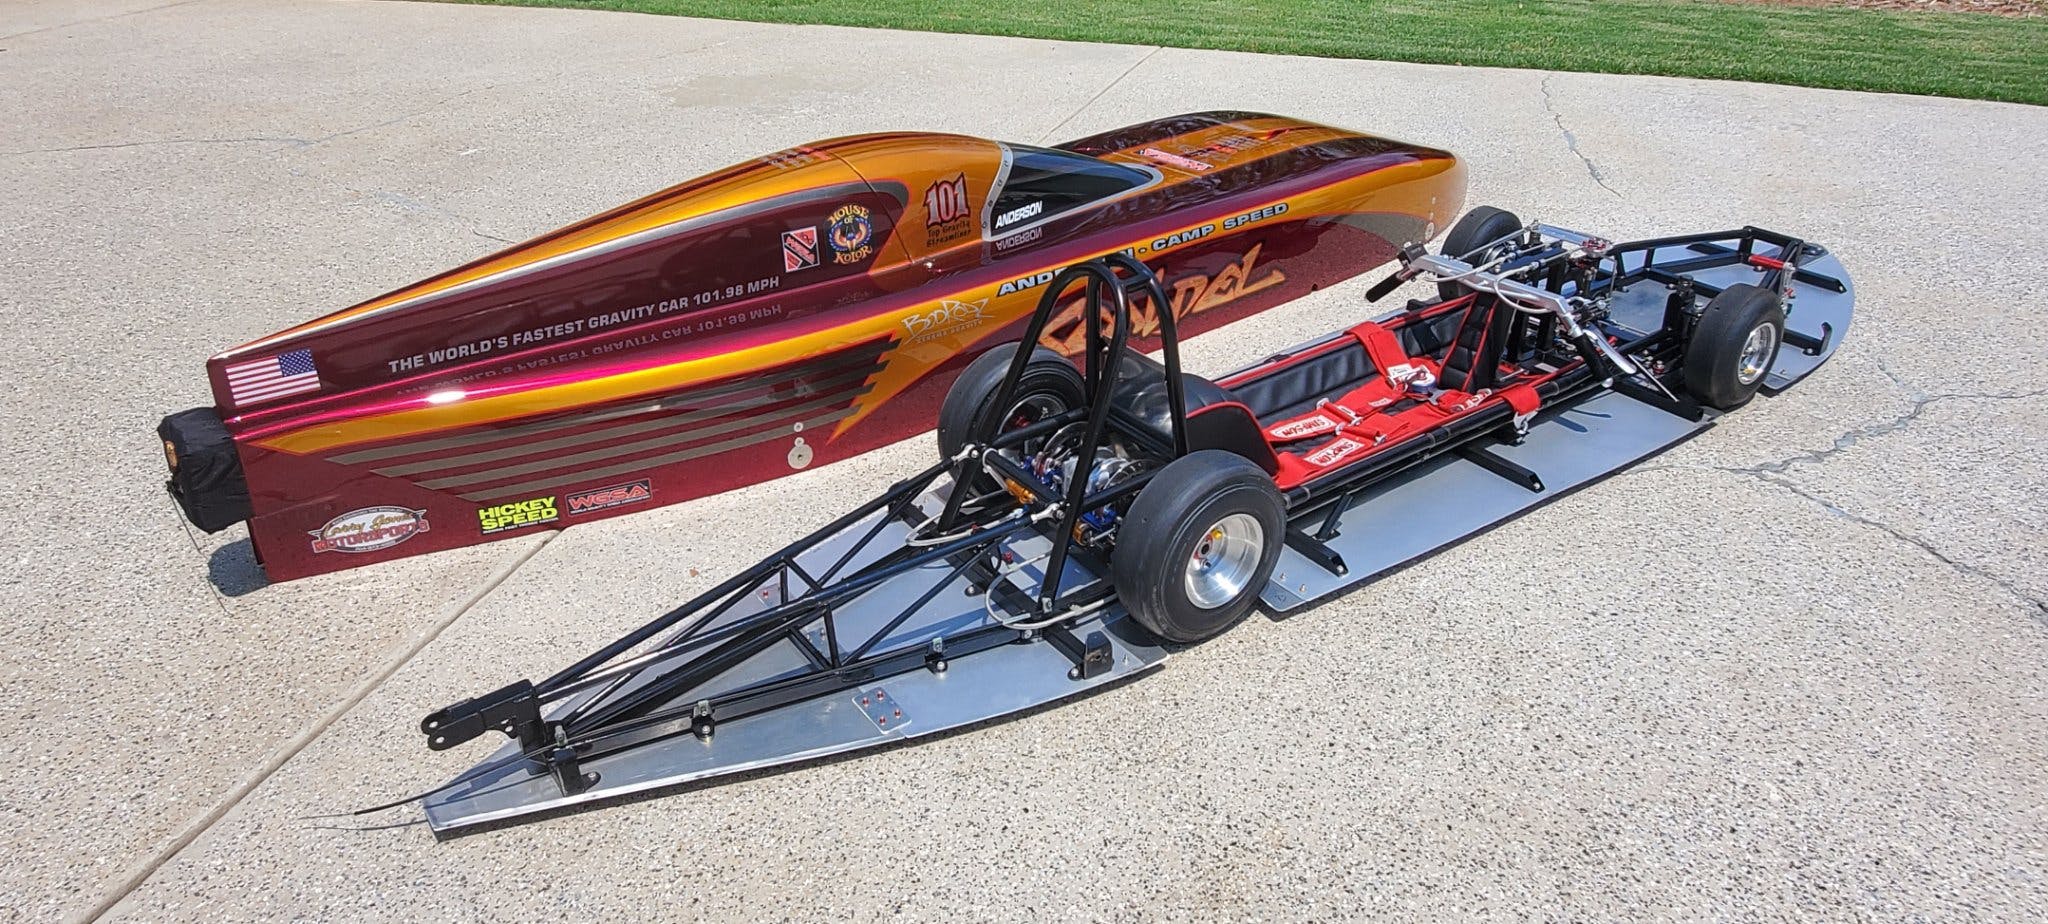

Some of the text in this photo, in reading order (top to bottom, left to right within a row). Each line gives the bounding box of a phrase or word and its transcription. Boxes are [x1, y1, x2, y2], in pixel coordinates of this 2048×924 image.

[923, 172, 970, 228] 101
[827, 204, 869, 226] HOUSE
[995, 201, 1043, 229] ANDERSON
[833, 245, 873, 265] KOLOR
[996, 248, 1135, 297] ANDN
[1152, 224, 1215, 251] CAMP
[1223, 202, 1288, 230] SPEED
[388, 276, 779, 373] THE WORLD'S FASTEST GRAVITY CAR 101.98 MPH
[479, 496, 556, 520] HICKEY
[568, 485, 649, 510] WGSA
[481, 507, 558, 531] SPEED
[314, 519, 429, 552] MOTORSPORTS
